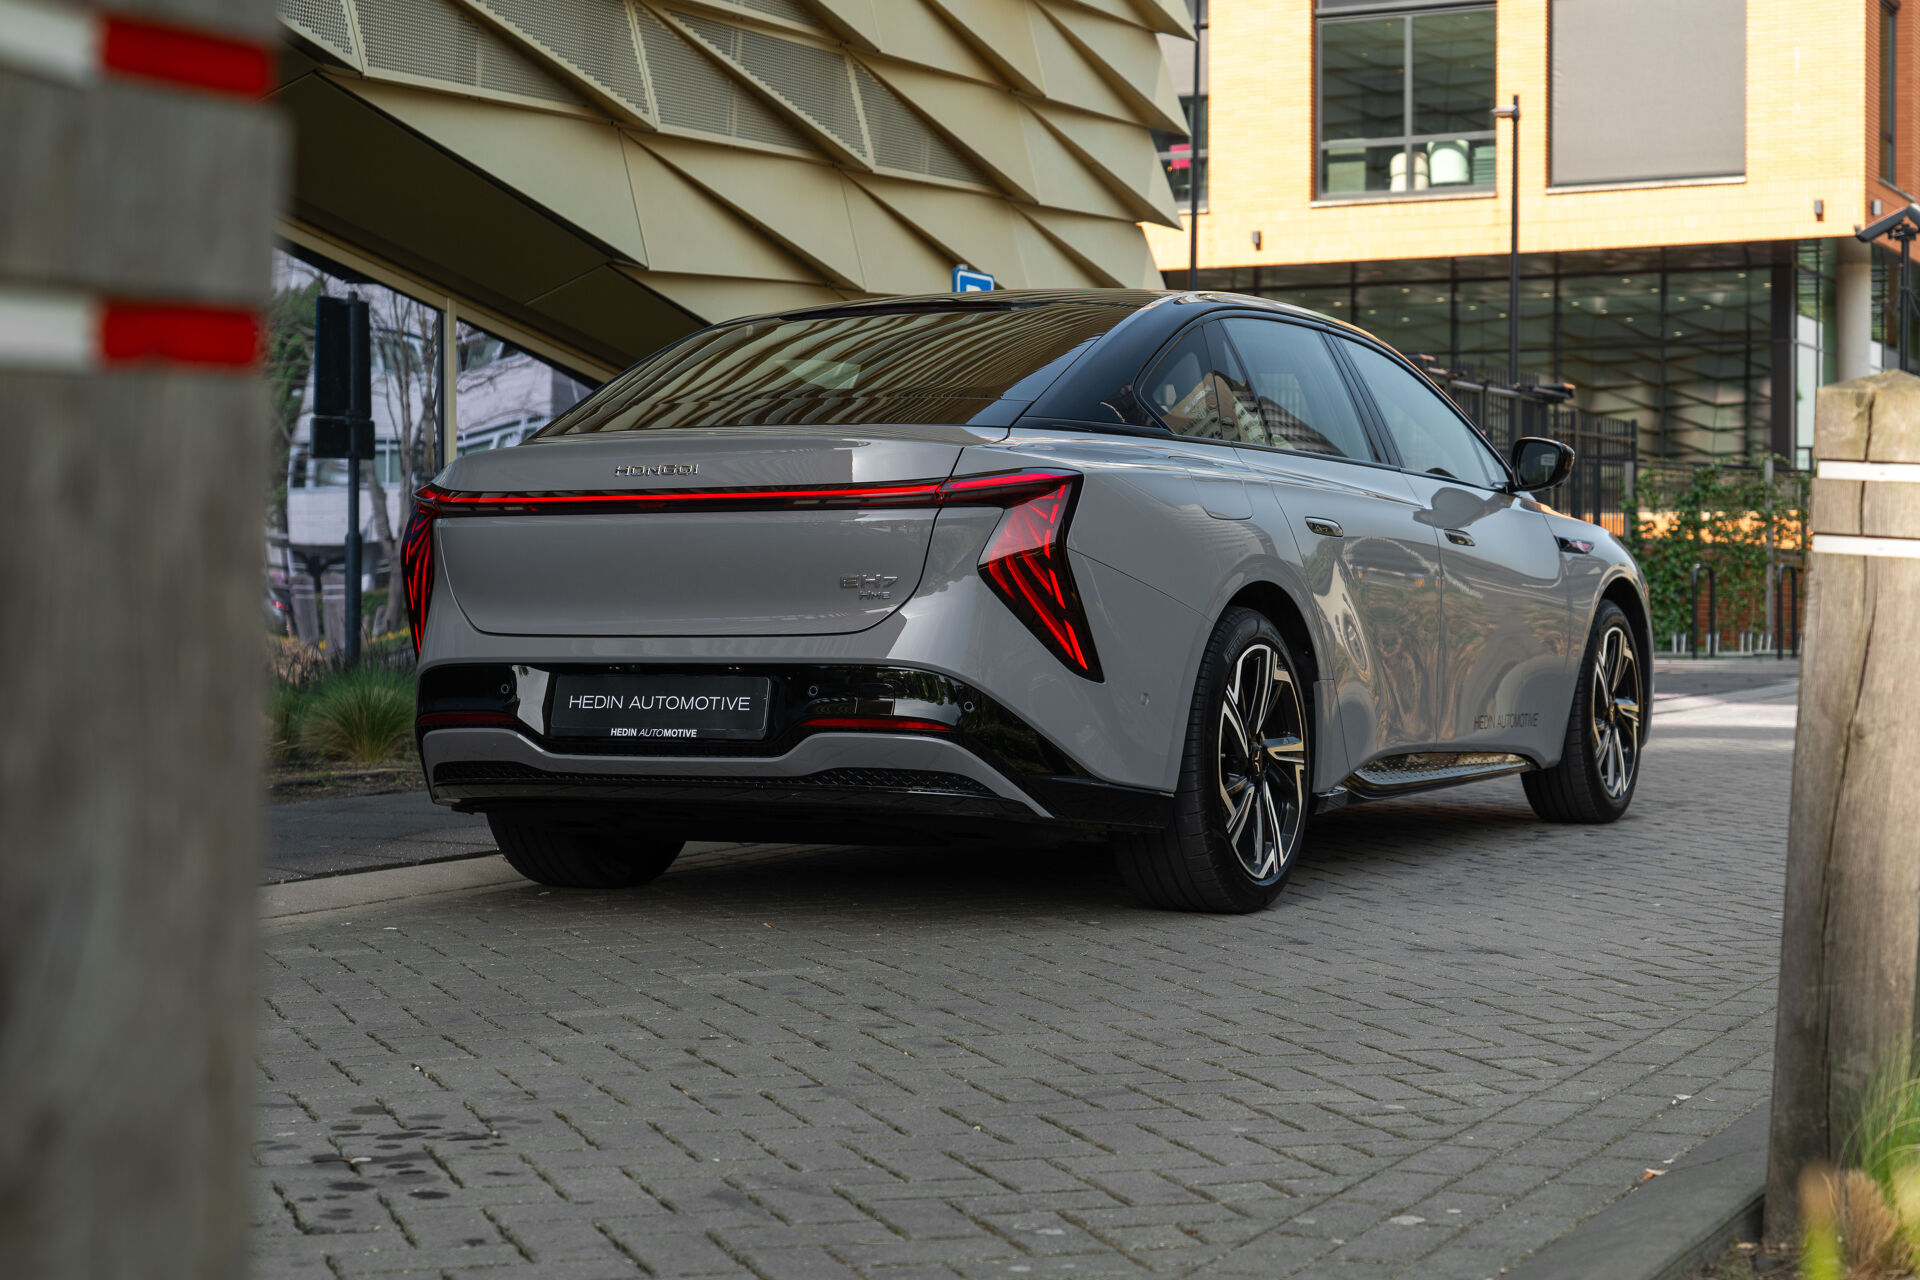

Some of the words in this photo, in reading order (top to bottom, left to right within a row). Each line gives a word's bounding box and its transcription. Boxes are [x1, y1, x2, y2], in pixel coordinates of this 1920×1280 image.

[614, 463, 699, 477] HONGQI
[841, 574, 898, 588] EH7
[568, 695, 624, 709] HEDIN
[628, 695, 751, 711] AUTOMOTIVE
[1473, 713, 1496, 730] HEDIN
[1497, 712, 1539, 728] AUTOMOTIVE
[610, 727, 637, 737] HEDIN
[638, 728, 697, 738] AUTOMOTIVE
